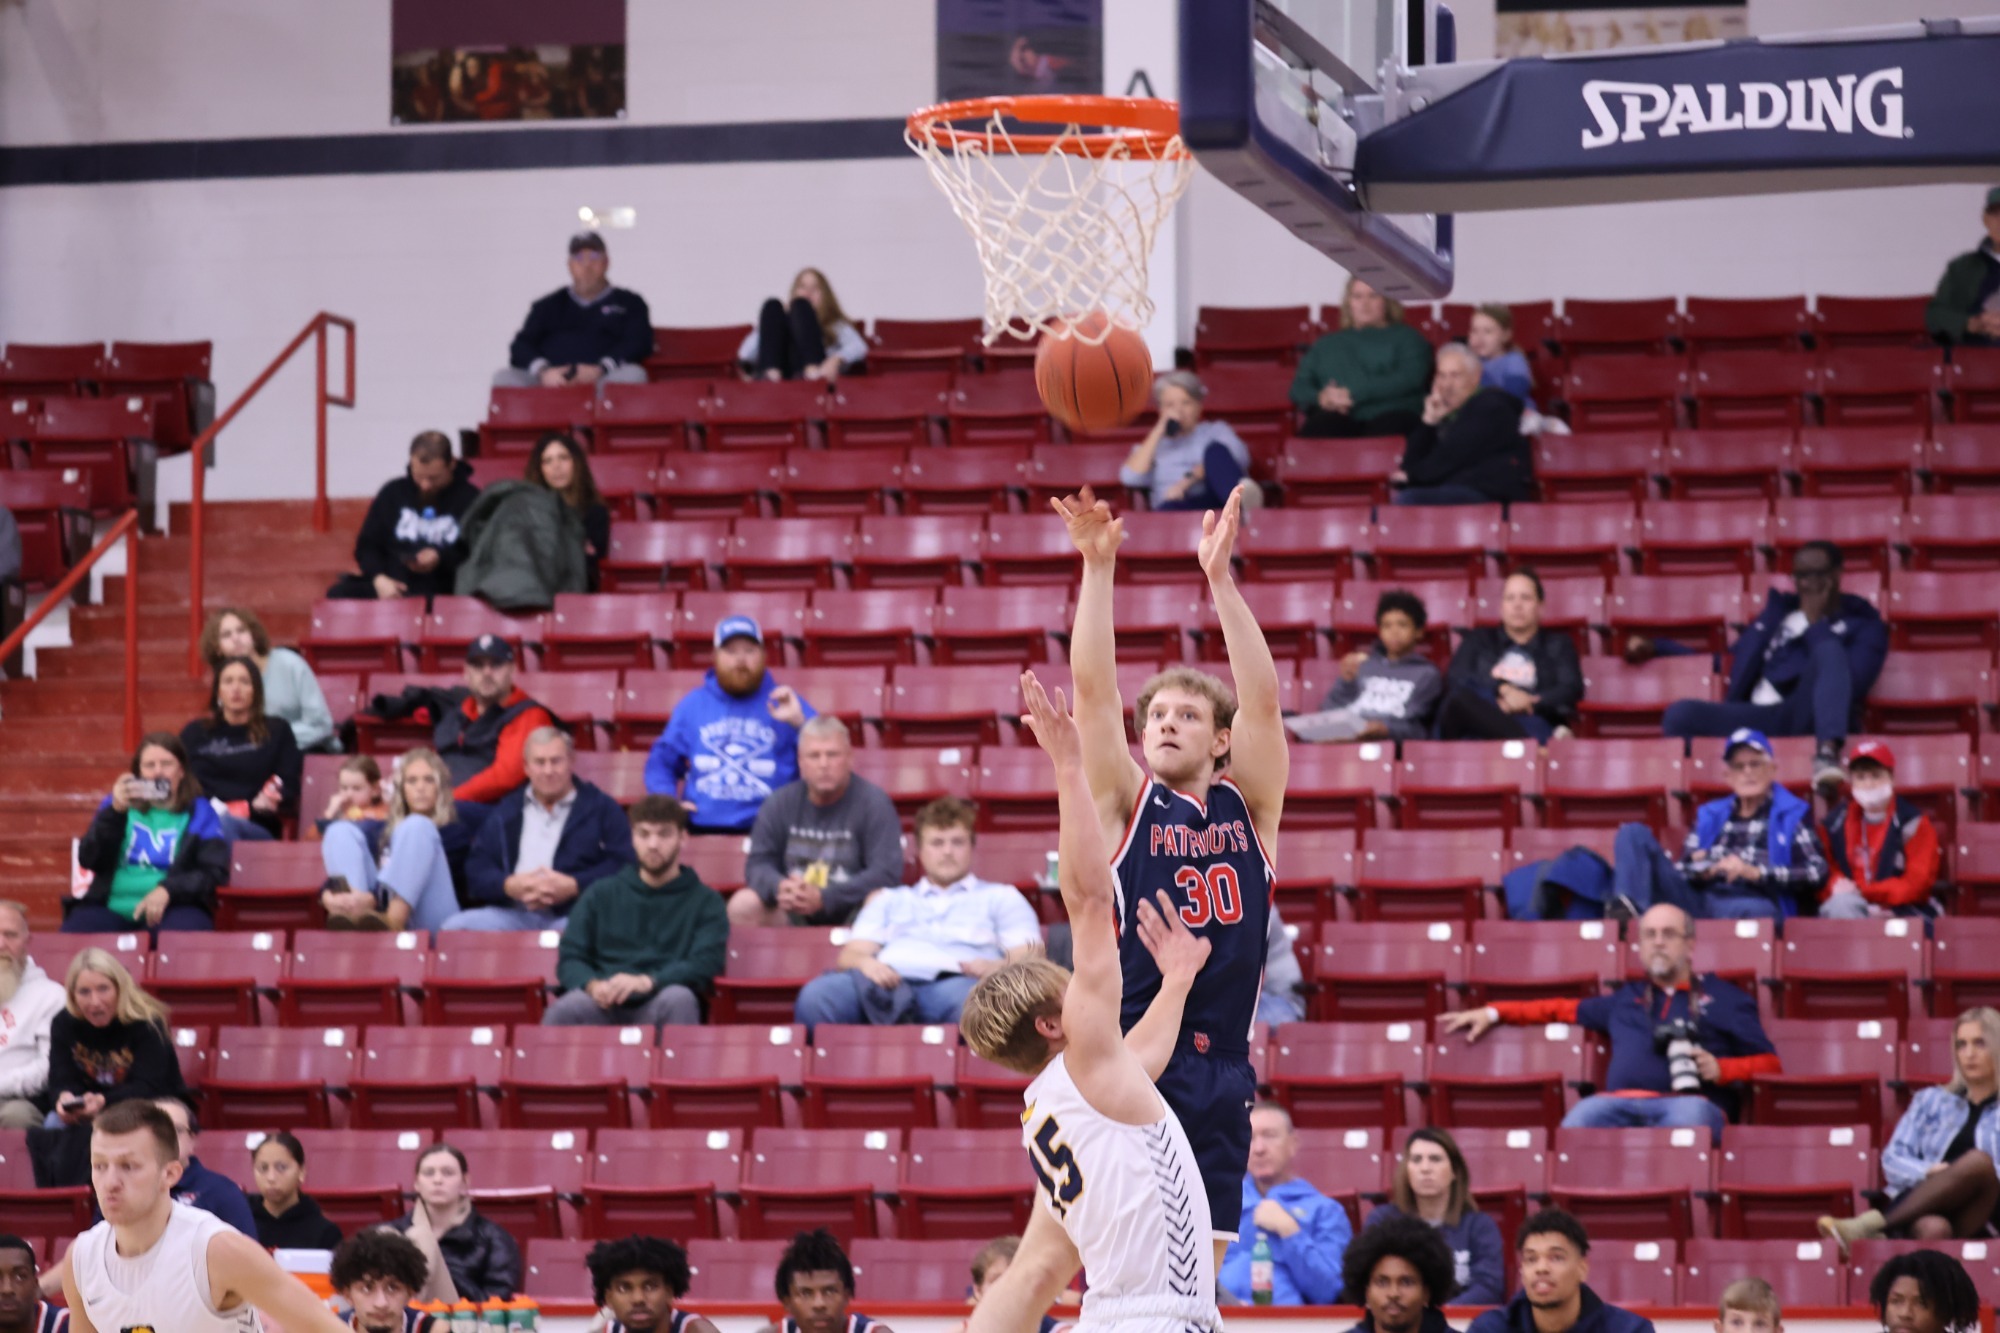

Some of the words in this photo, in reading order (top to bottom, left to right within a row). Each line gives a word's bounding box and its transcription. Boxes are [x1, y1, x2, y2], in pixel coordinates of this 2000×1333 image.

[1582, 66, 1904, 149] SPALDING
[1151, 820, 1248, 858] PATRIOTS
[1174, 862, 1243, 928] 30
